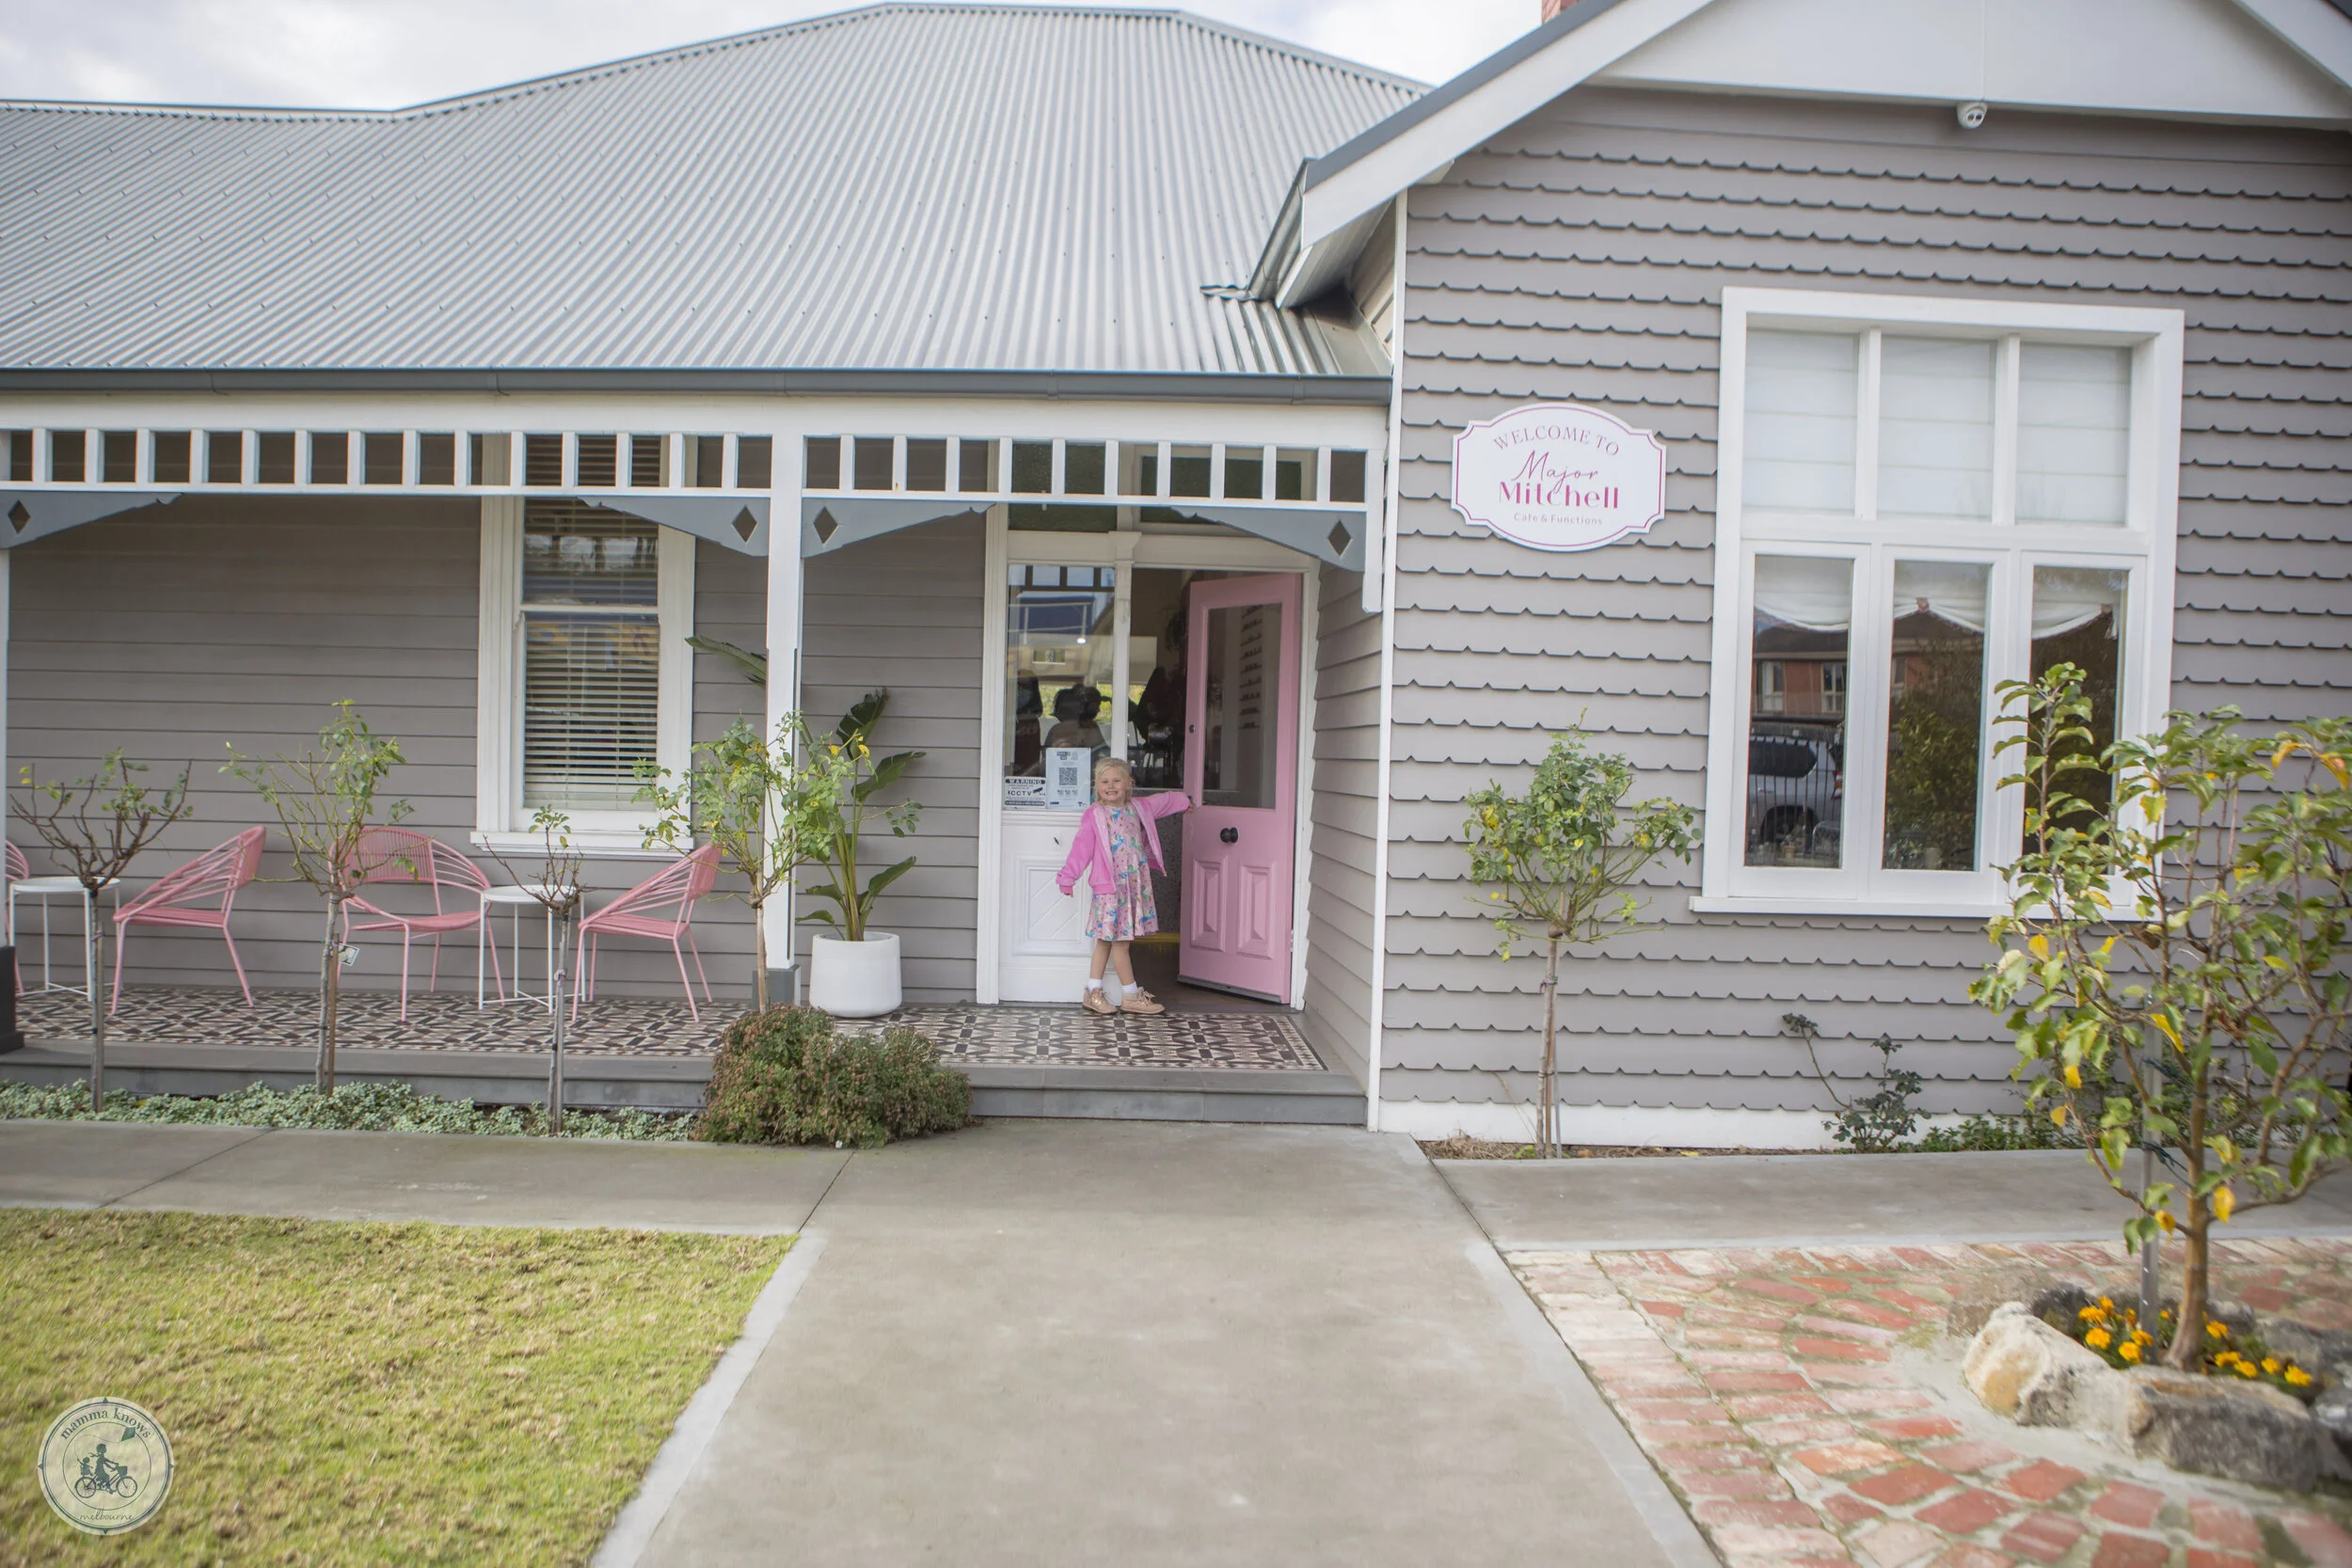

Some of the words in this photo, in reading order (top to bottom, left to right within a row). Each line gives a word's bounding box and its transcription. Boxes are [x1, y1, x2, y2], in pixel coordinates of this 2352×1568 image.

[1493, 424, 1591, 451] WELCOME
[1597, 435, 1619, 456] TO
[1511, 450, 1598, 495] Major
[1499, 481, 1619, 509] Mitchell
[1540, 514, 1548, 523] &
[1550, 514, 1602, 526] Functions
